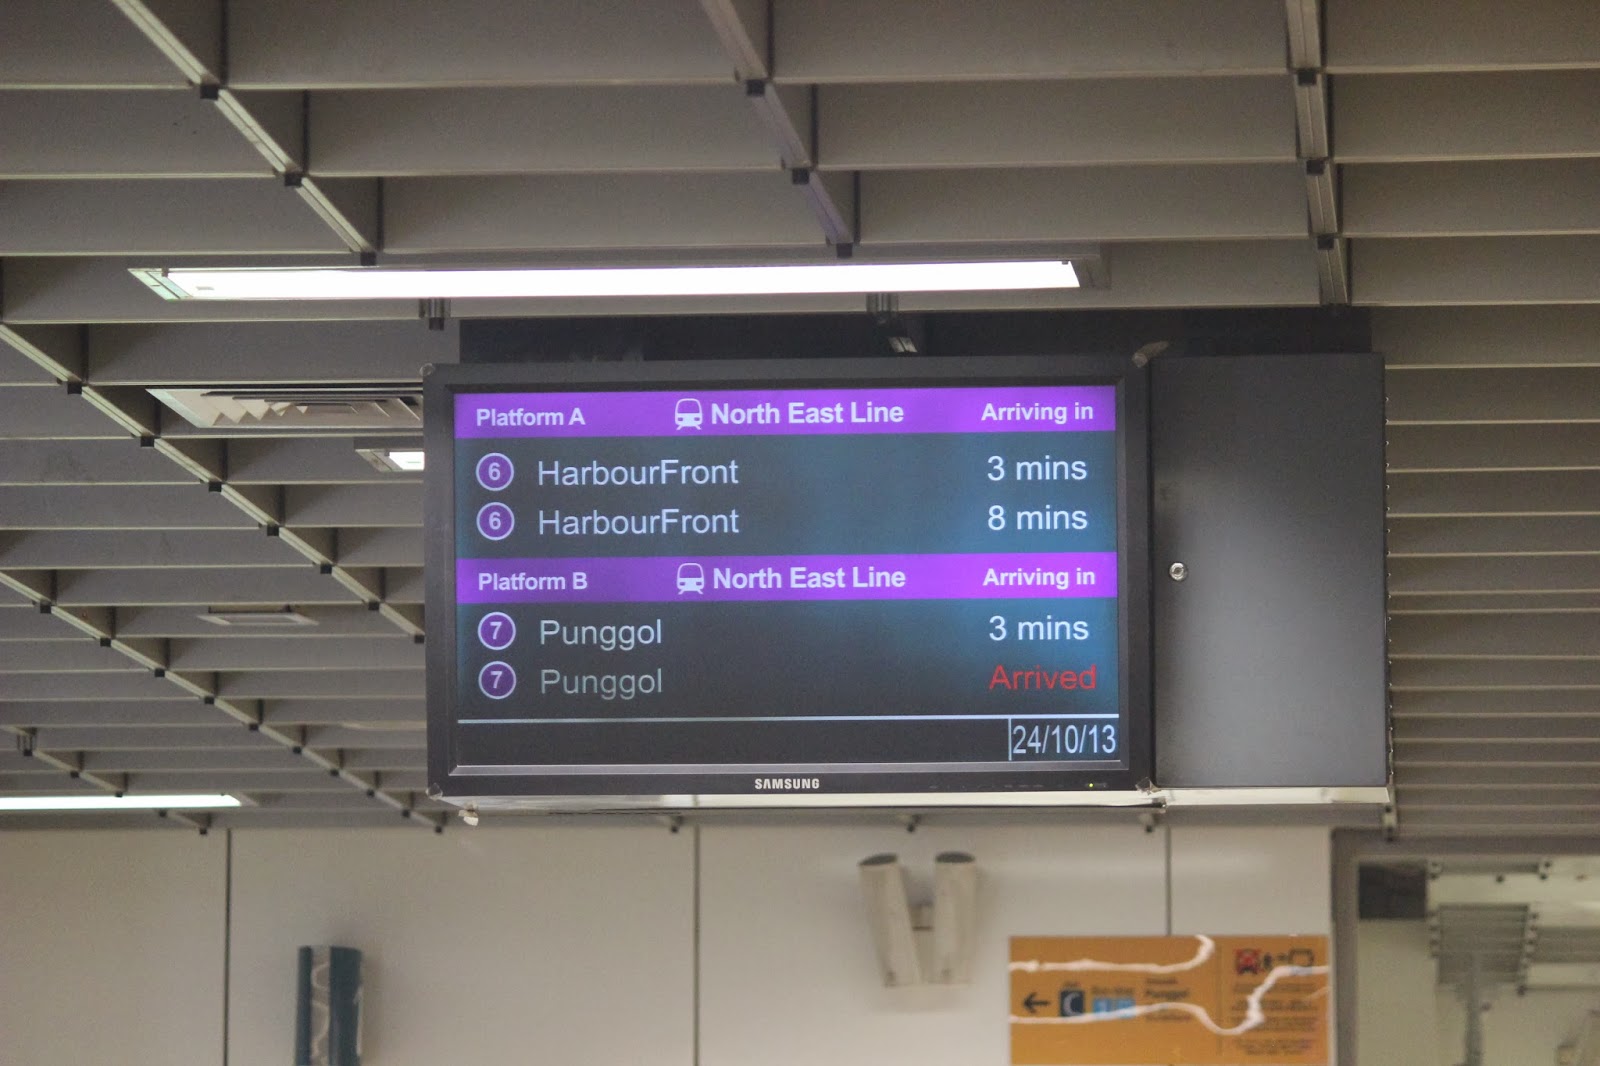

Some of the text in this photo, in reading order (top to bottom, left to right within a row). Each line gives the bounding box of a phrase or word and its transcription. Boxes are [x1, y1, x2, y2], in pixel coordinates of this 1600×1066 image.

[477, 408, 585, 427] Platform A
[711, 401, 904, 424] North East Line
[981, 402, 1093, 424] Arriving in
[488, 459, 739, 486] 6 HarbourFront
[987, 455, 1087, 481] 3 mins
[488, 508, 740, 535] 6 HarbourFront
[988, 505, 1088, 530] 8 mins
[478, 572, 588, 590] Platform B
[713, 566, 906, 589] North East Line
[983, 568, 1095, 589] Arriving in
[489, 618, 662, 651] 7 Punggol
[989, 615, 1089, 641] 3 mins
[490, 668, 662, 700] 7 Punggol
[989, 664, 1097, 690] Arrived
[1013, 724, 1117, 754] 24/10/13
[754, 778, 820, 790] SAMSUNG
